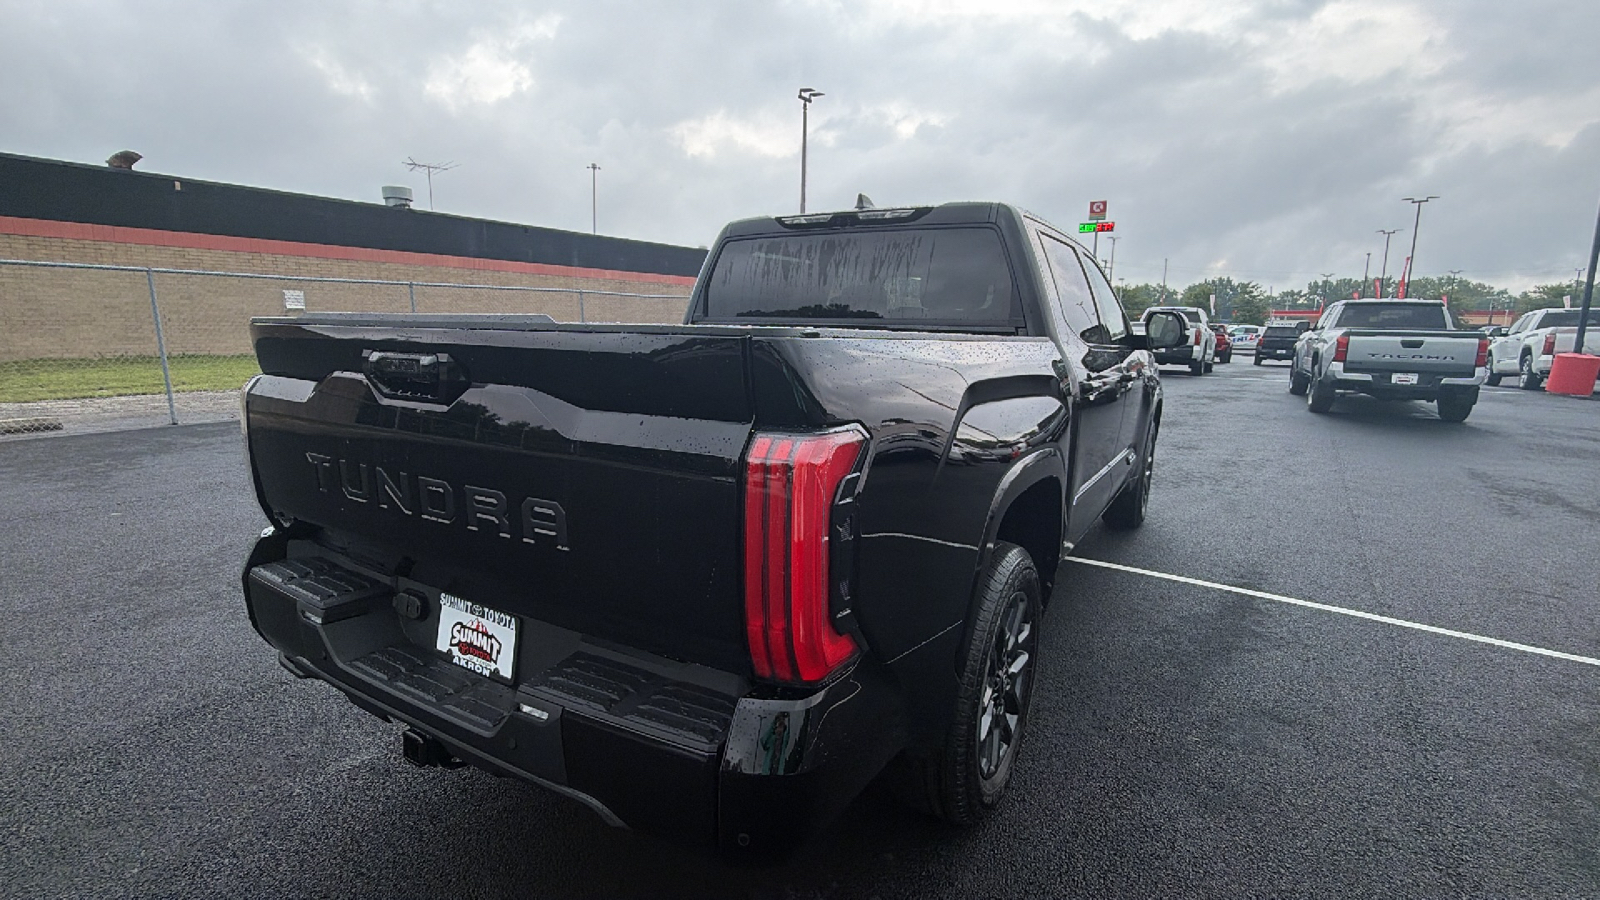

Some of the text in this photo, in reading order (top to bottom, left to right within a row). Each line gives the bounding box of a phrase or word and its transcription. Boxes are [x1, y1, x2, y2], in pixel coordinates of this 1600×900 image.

[1367, 353, 1455, 361] TACOMA
[305, 451, 571, 552] TUNDRA
[440, 592, 515, 631] SUMMIT TOYOTA
[450, 622, 501, 662] SUMMIT
[469, 646, 491, 661] TOYOTA
[452, 655, 491, 678] AKRON
